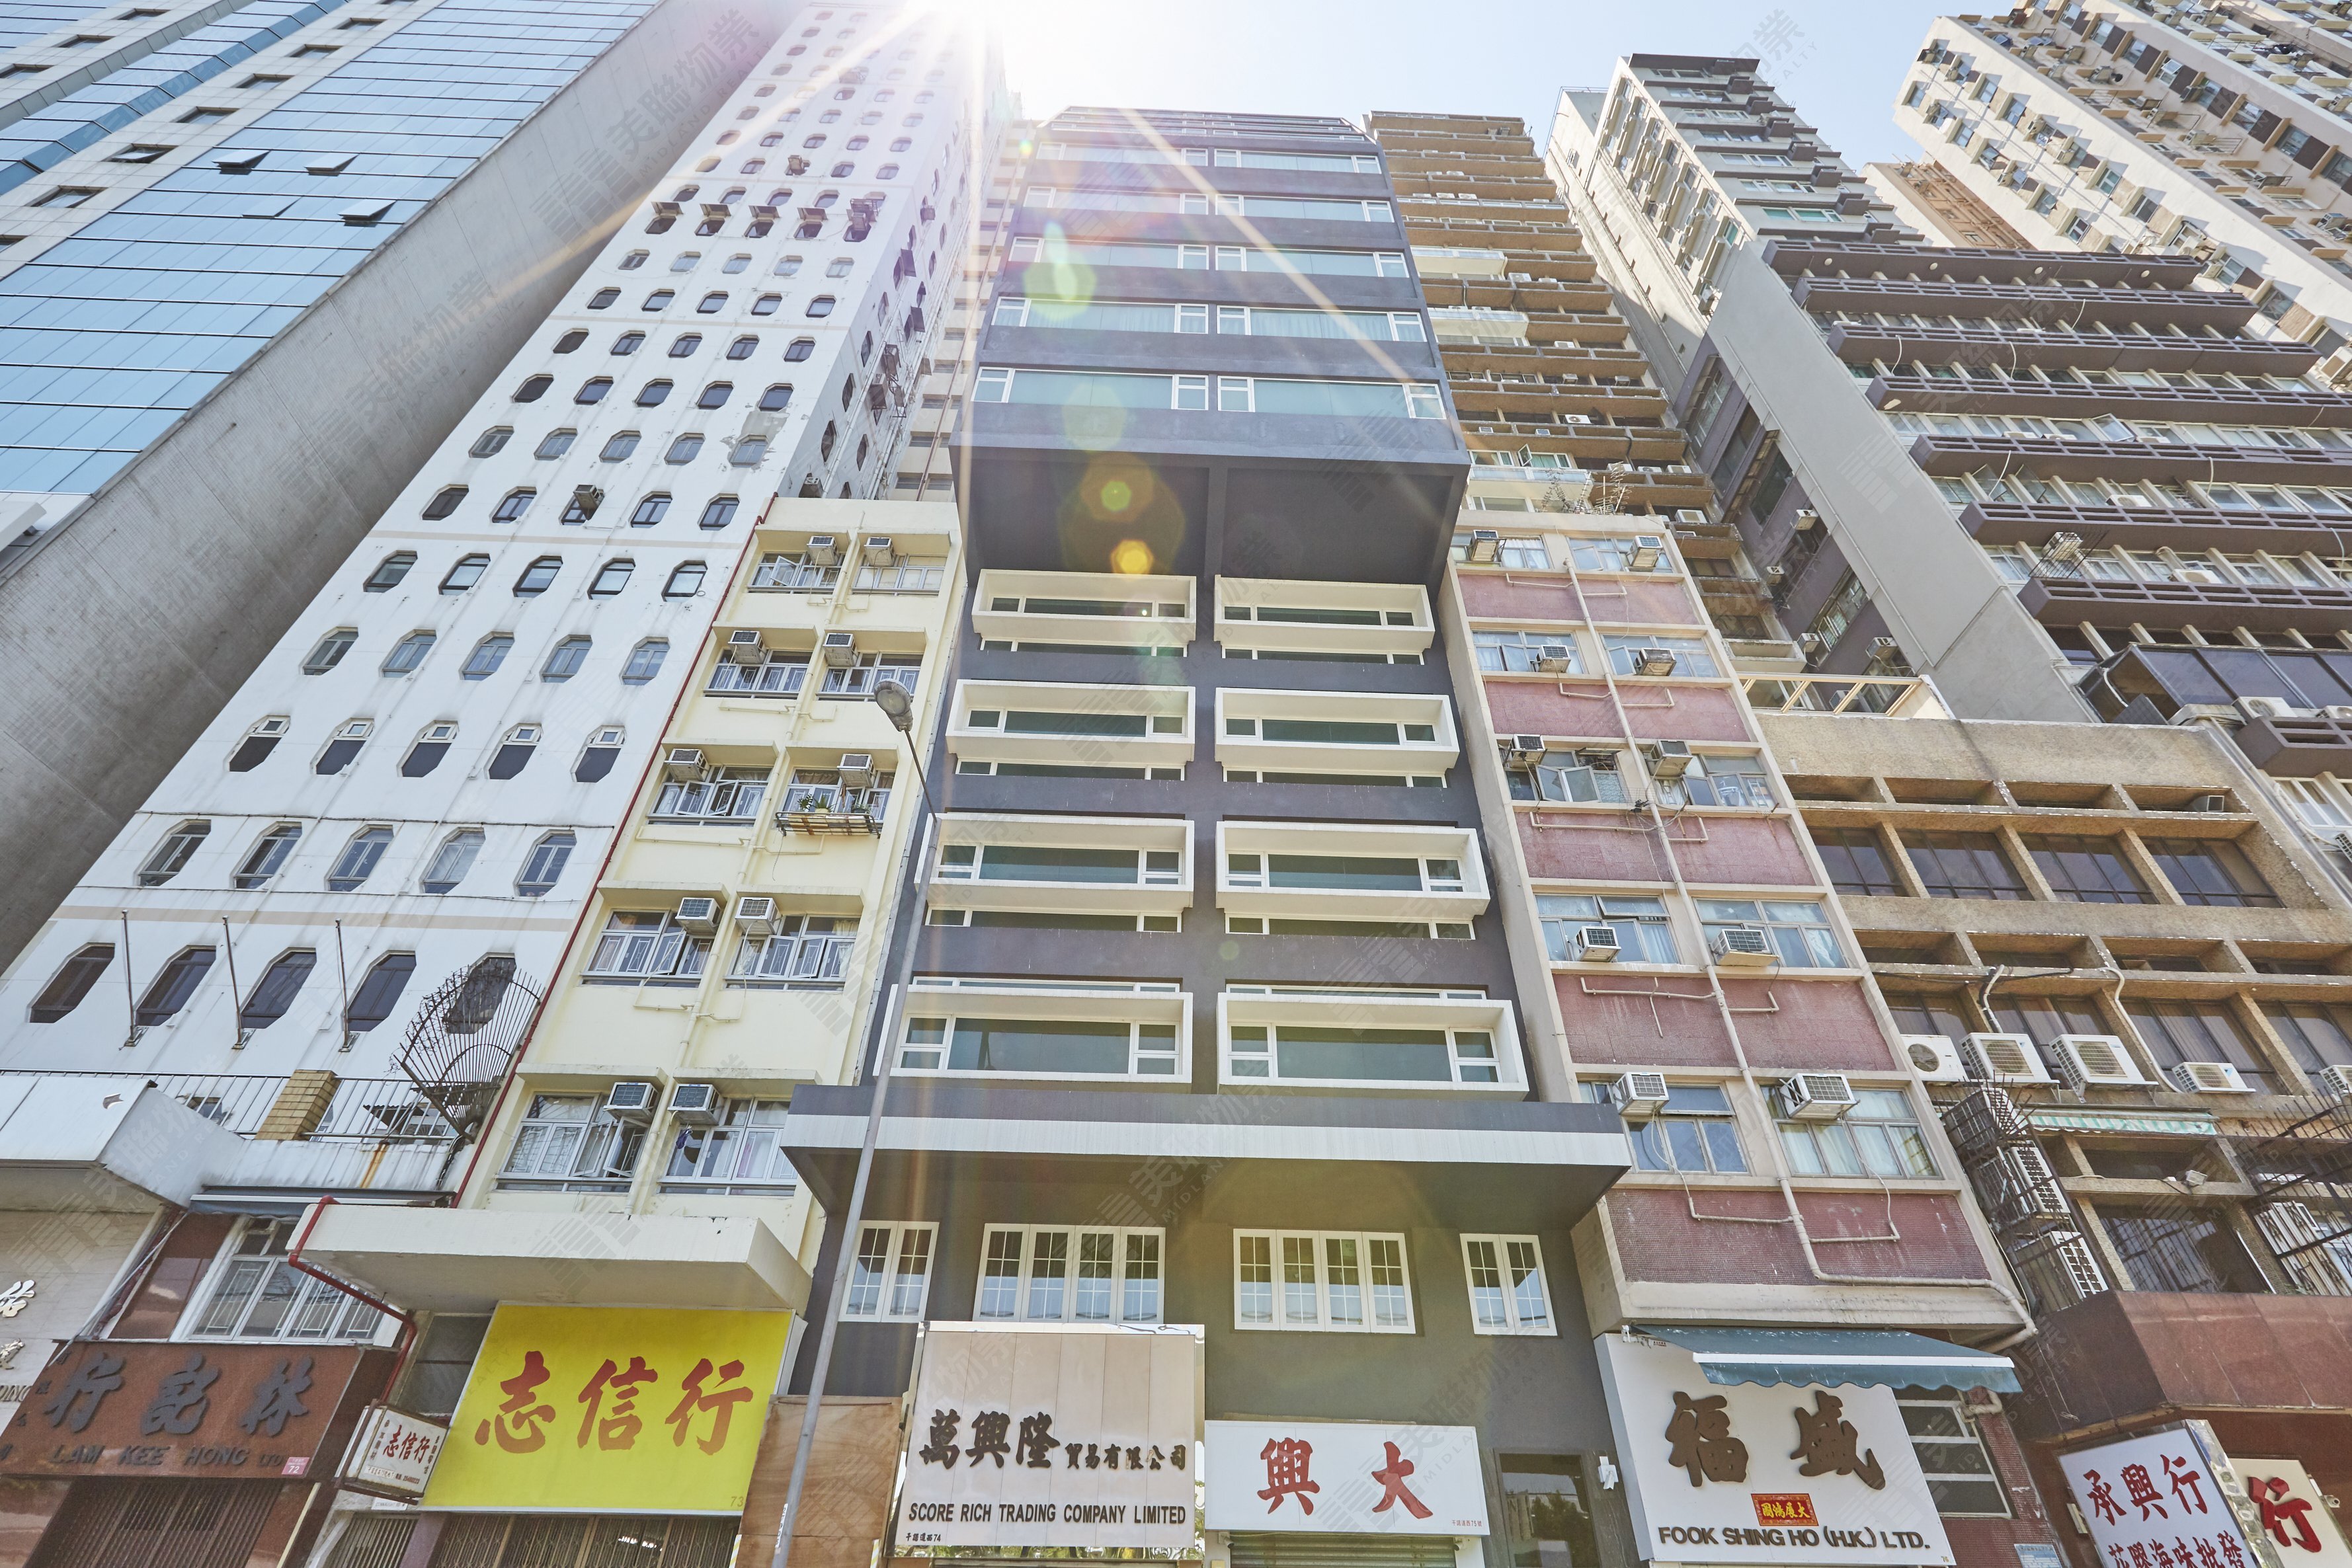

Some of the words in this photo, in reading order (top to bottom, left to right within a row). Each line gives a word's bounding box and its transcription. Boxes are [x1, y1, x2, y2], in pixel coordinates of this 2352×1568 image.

[474, 1351, 753, 1455] 志信行
[50, 1444, 105, 1466] LAM
[118, 1445, 171, 1466] KEE
[184, 1445, 250, 1466] HONG
[258, 1454, 285, 1466] LTD
[382, 1425, 430, 1464] 志信行
[730, 1496, 745, 1507] 73
[909, 1503, 955, 1522] SCORE
[960, 1503, 992, 1522] RICH
[998, 1504, 1056, 1522] TRADING
[1063, 1505, 1126, 1524] COMPANY
[1134, 1505, 1186, 1524] LIMITED
[1658, 1526, 1719, 1546] FOOK
[1722, 1527, 1787, 1547] SHING
[1788, 1529, 1820, 1548] HO
[1880, 1531, 1931, 1549] LTD.
